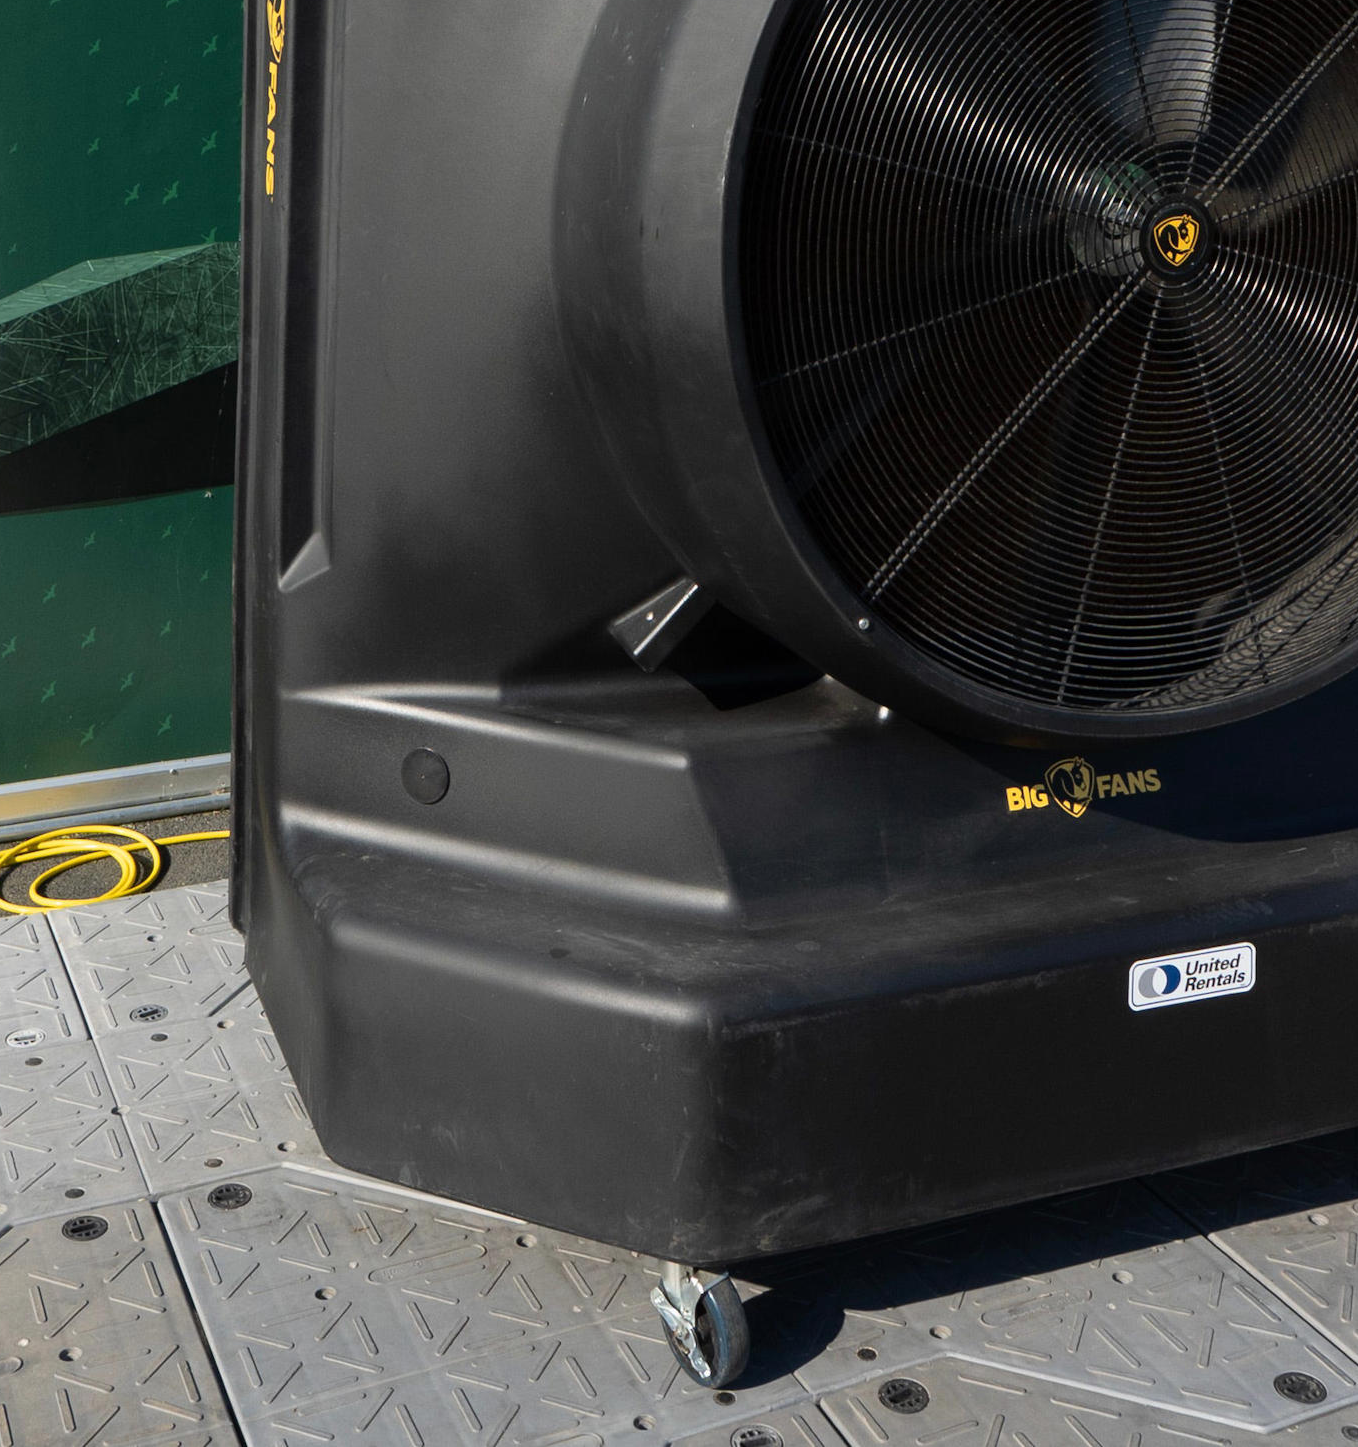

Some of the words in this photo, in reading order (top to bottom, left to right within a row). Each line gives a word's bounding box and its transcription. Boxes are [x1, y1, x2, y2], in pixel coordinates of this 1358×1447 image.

[265, 61, 278, 196] FANS
[1006, 784, 1049, 812] BIG
[1096, 768, 1162, 799] FANS
[1184, 954, 1241, 977] United
[1184, 969, 1246, 993] Rentals
